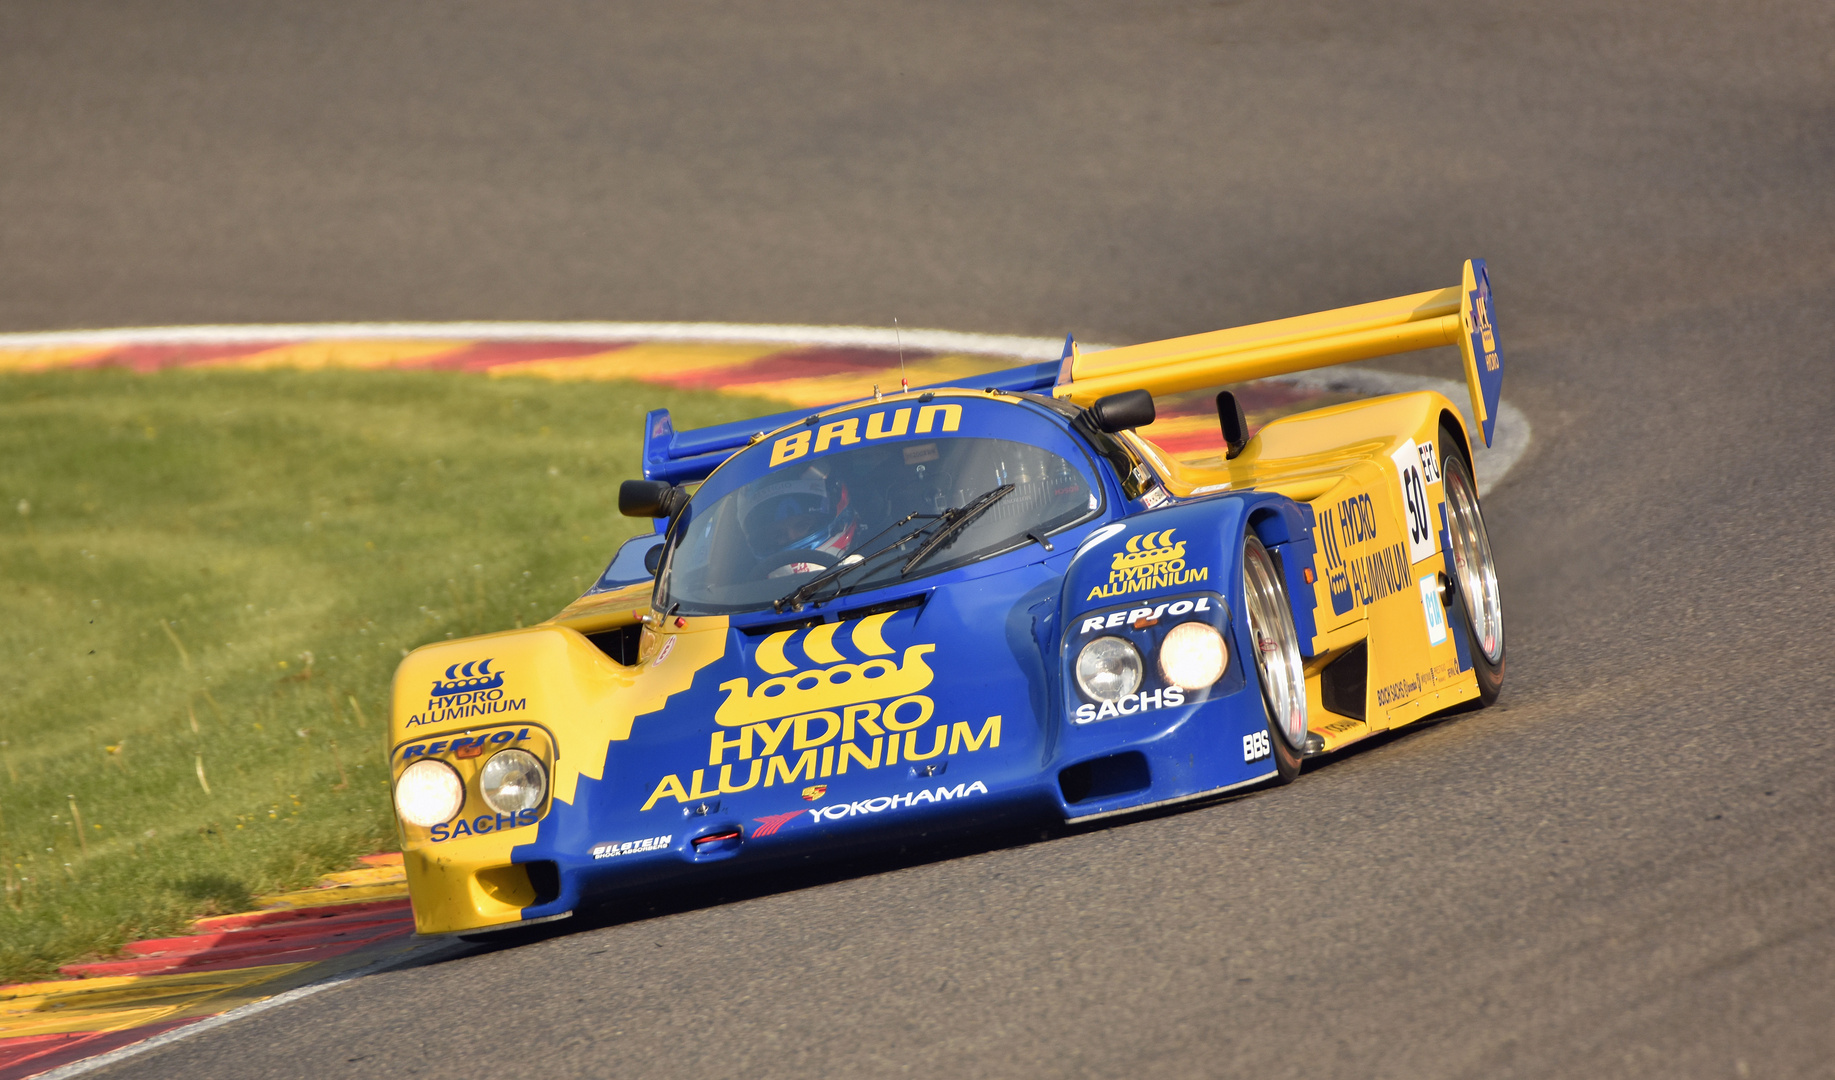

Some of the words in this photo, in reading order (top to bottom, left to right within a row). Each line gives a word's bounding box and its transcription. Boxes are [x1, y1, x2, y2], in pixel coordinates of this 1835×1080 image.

[1485, 352, 1500, 372] HYDRO
[769, 404, 963, 468] BRUN
[1337, 492, 1377, 548] HYDRO
[1403, 465, 1429, 545] 50
[1086, 567, 1209, 601] ALUMINIUM
[1109, 558, 1186, 584] HYDRO
[1351, 541, 1413, 608] ALUMINIUM
[1080, 597, 1211, 634] REPSOL
[405, 698, 527, 728] ALUMINIUM
[427, 688, 505, 711] HYDRO
[1075, 686, 1185, 724] SACHS
[402, 728, 532, 760] REPSOL
[708, 695, 935, 766] HYDRO
[1243, 729, 1271, 762] BBS
[640, 715, 1002, 812] ALUMINIUM
[808, 781, 988, 823] YOKOHAMA
[430, 808, 540, 843] SACHS
[593, 834, 673, 855] BILSTEIN
